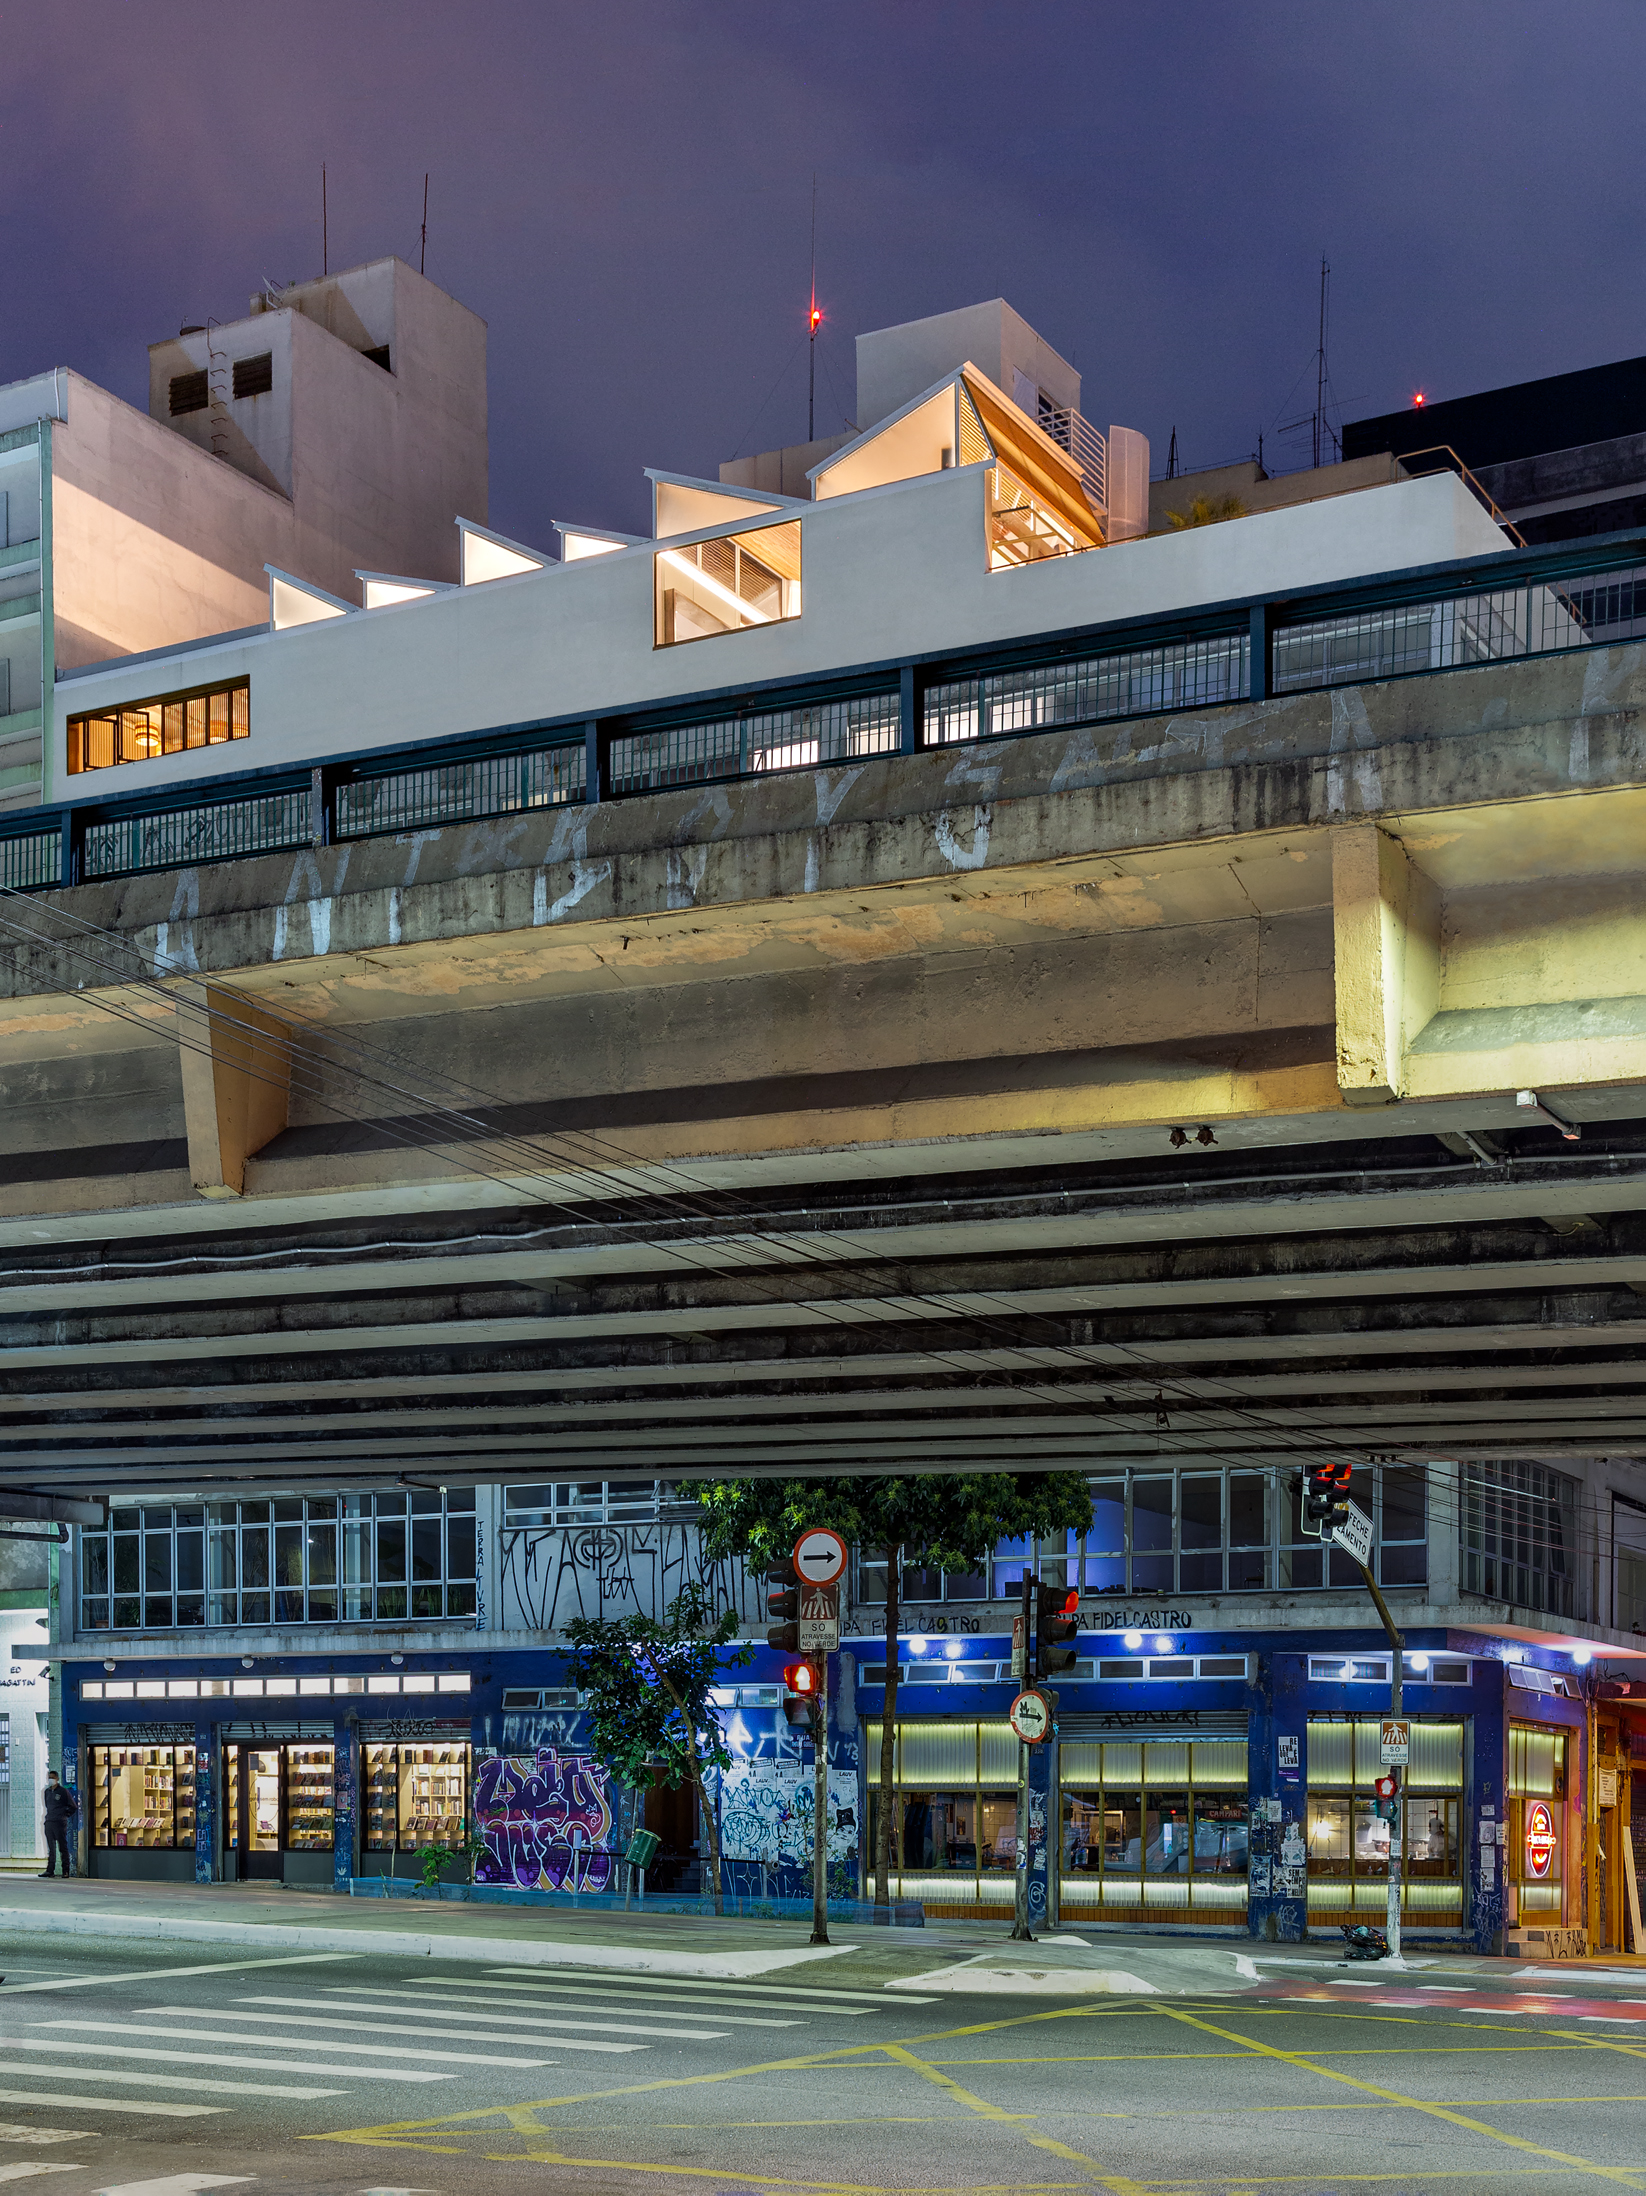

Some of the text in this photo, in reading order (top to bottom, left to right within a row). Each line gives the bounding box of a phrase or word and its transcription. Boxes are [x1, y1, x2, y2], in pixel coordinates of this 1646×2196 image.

[1349, 1512, 1369, 1539] FECHE
[811, 1621, 825, 1631] SÓ
[1389, 1745, 1401, 1753] SÓ
[1209, 1810, 1241, 1818] CAMPARI
